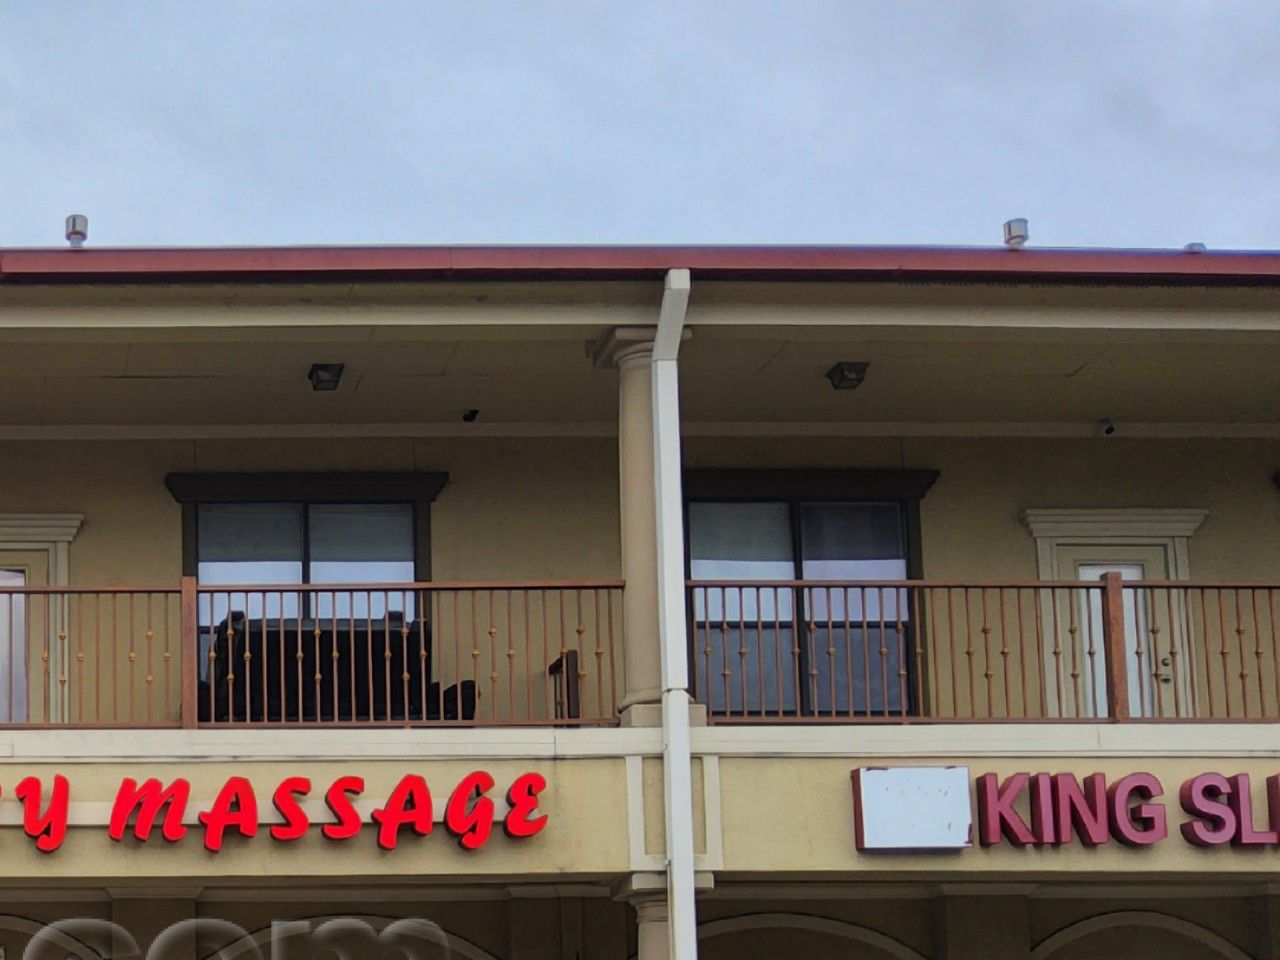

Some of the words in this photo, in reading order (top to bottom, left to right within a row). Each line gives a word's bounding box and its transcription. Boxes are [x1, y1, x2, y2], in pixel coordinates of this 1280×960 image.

[108, 770, 549, 852] MASSAGE
[976, 772, 1168, 847] KING
[1180, 772, 1280, 847] SL
